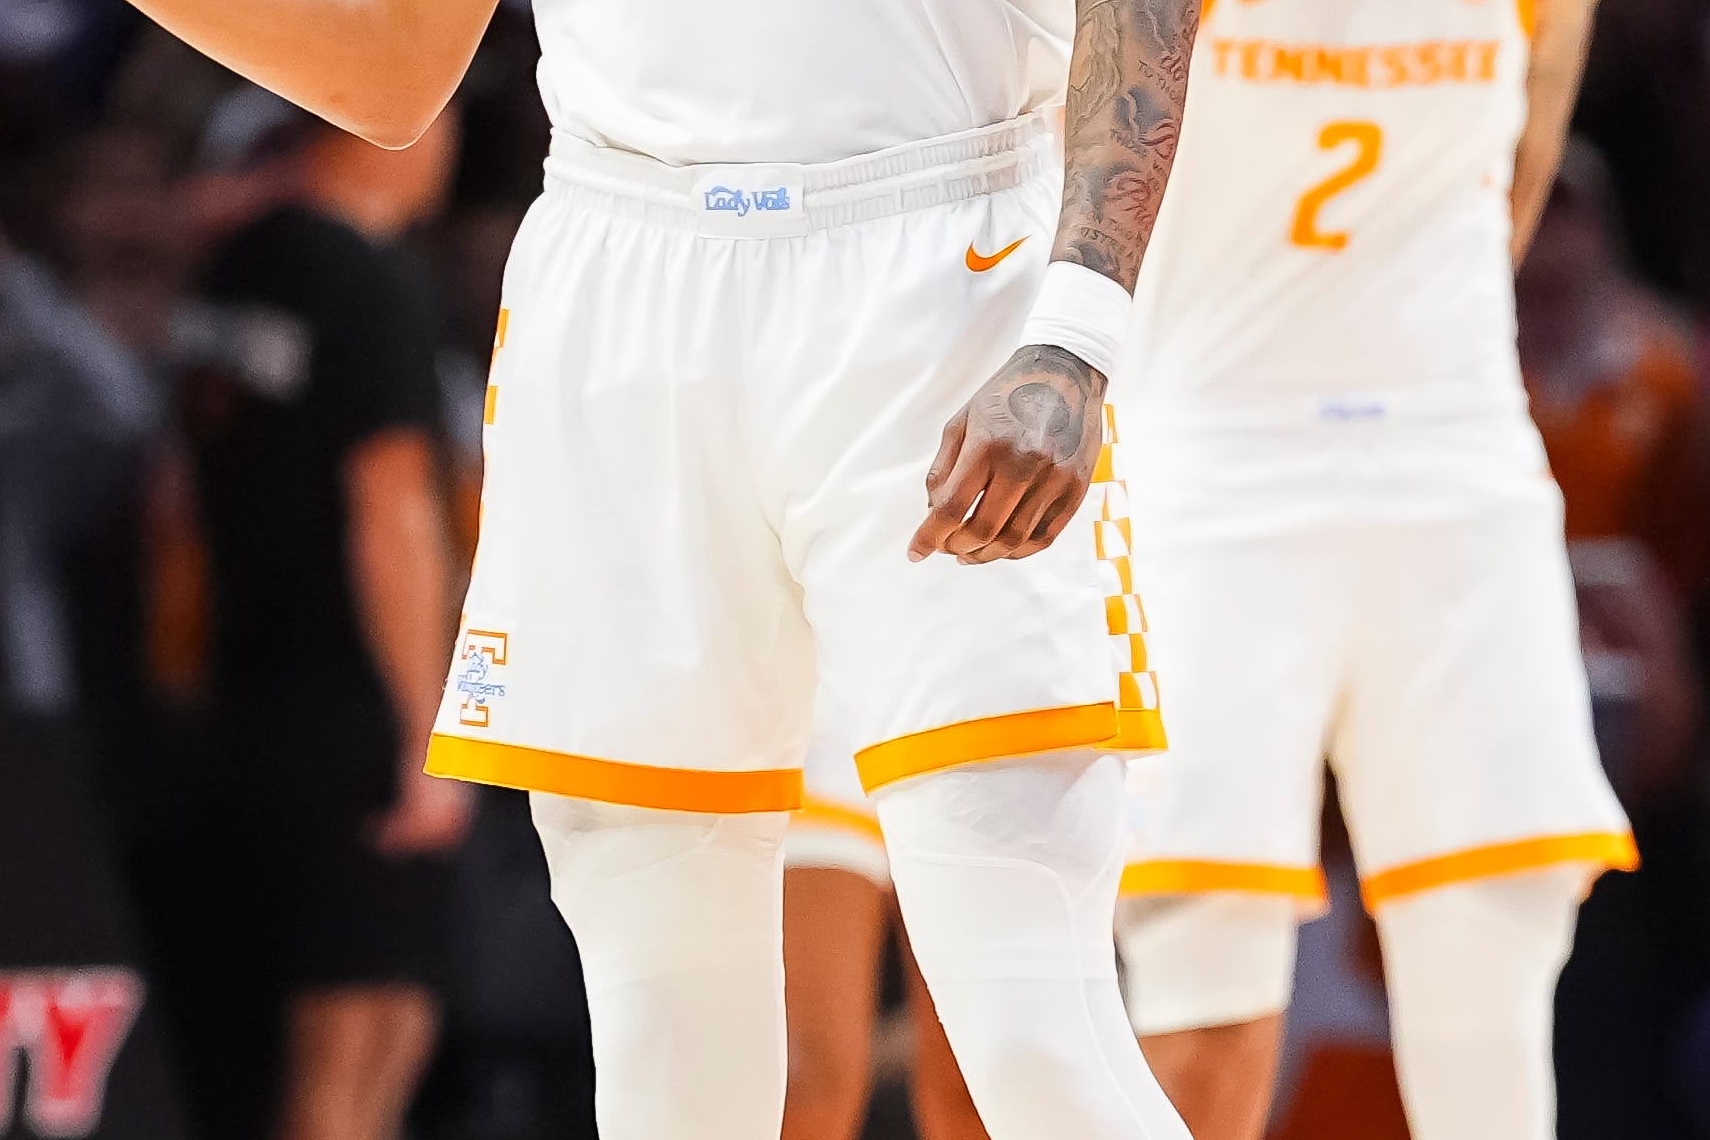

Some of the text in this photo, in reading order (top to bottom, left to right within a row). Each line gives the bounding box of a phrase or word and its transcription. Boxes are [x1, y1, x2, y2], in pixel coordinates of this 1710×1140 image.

[1211, 37, 1500, 90] TENNESSEE
[704, 185, 750, 217] Lady
[1289, 119, 1383, 252] 2
